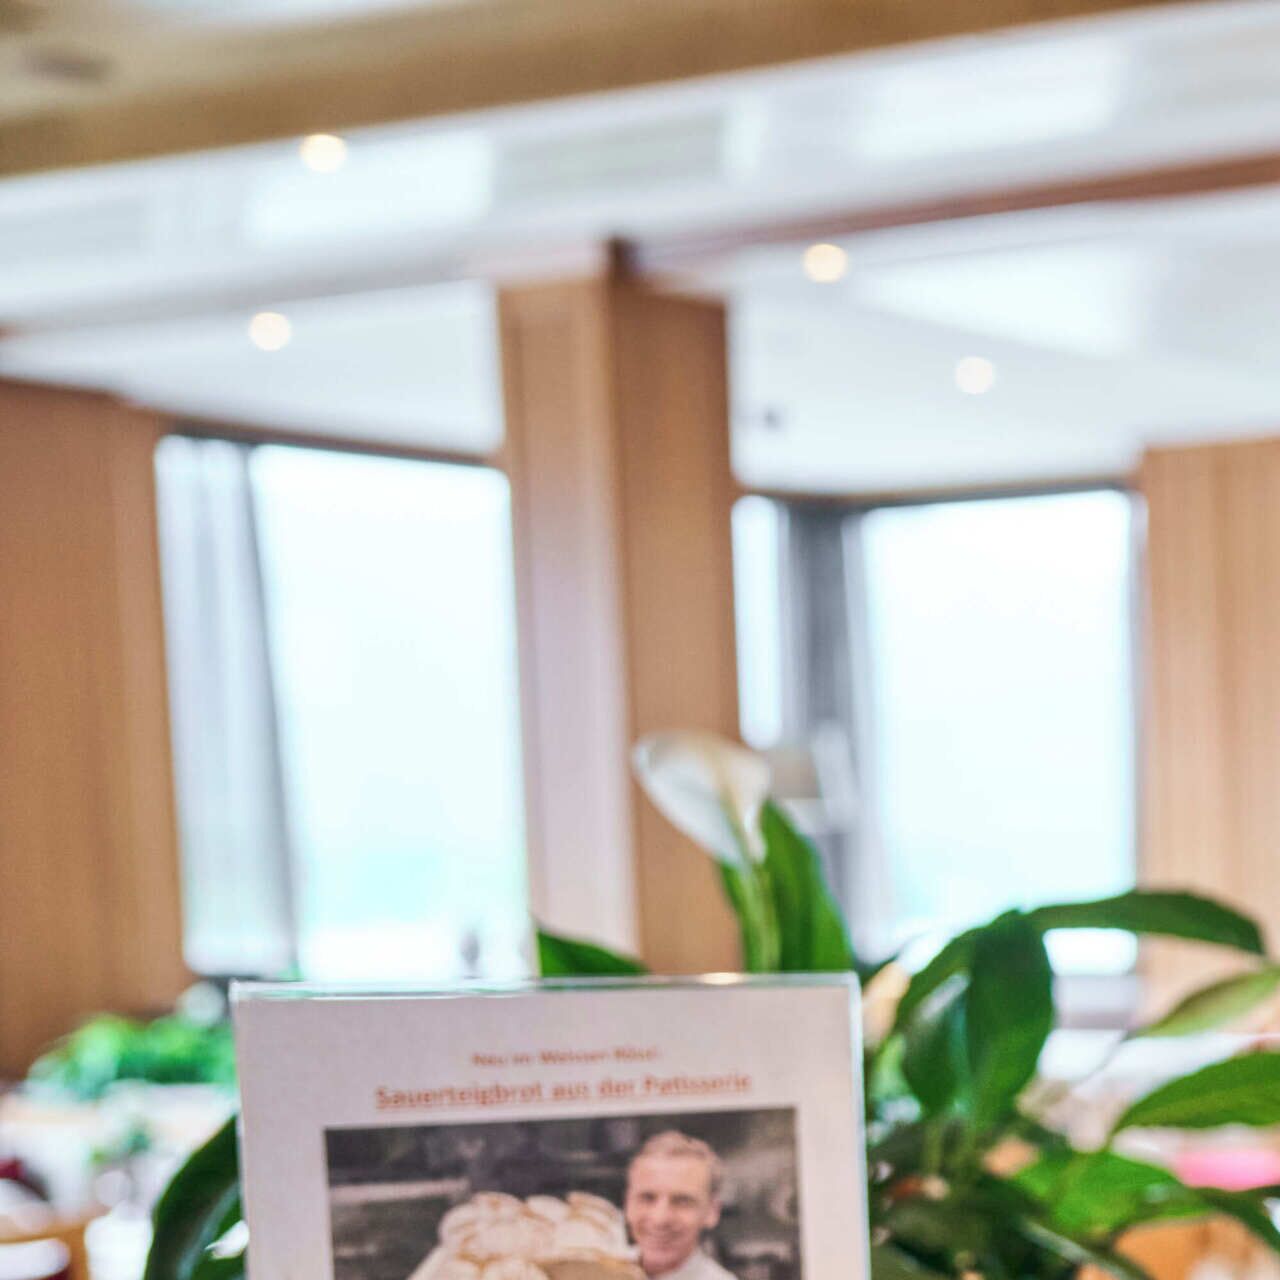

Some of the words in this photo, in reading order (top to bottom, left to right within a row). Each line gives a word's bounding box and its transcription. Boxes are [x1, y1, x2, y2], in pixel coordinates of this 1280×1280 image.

[375, 1080, 543, 1108] Sauerteigbrot
[551, 1082, 590, 1100] aus
[598, 1077, 635, 1098] der
[643, 1071, 754, 1095] Patisserie
